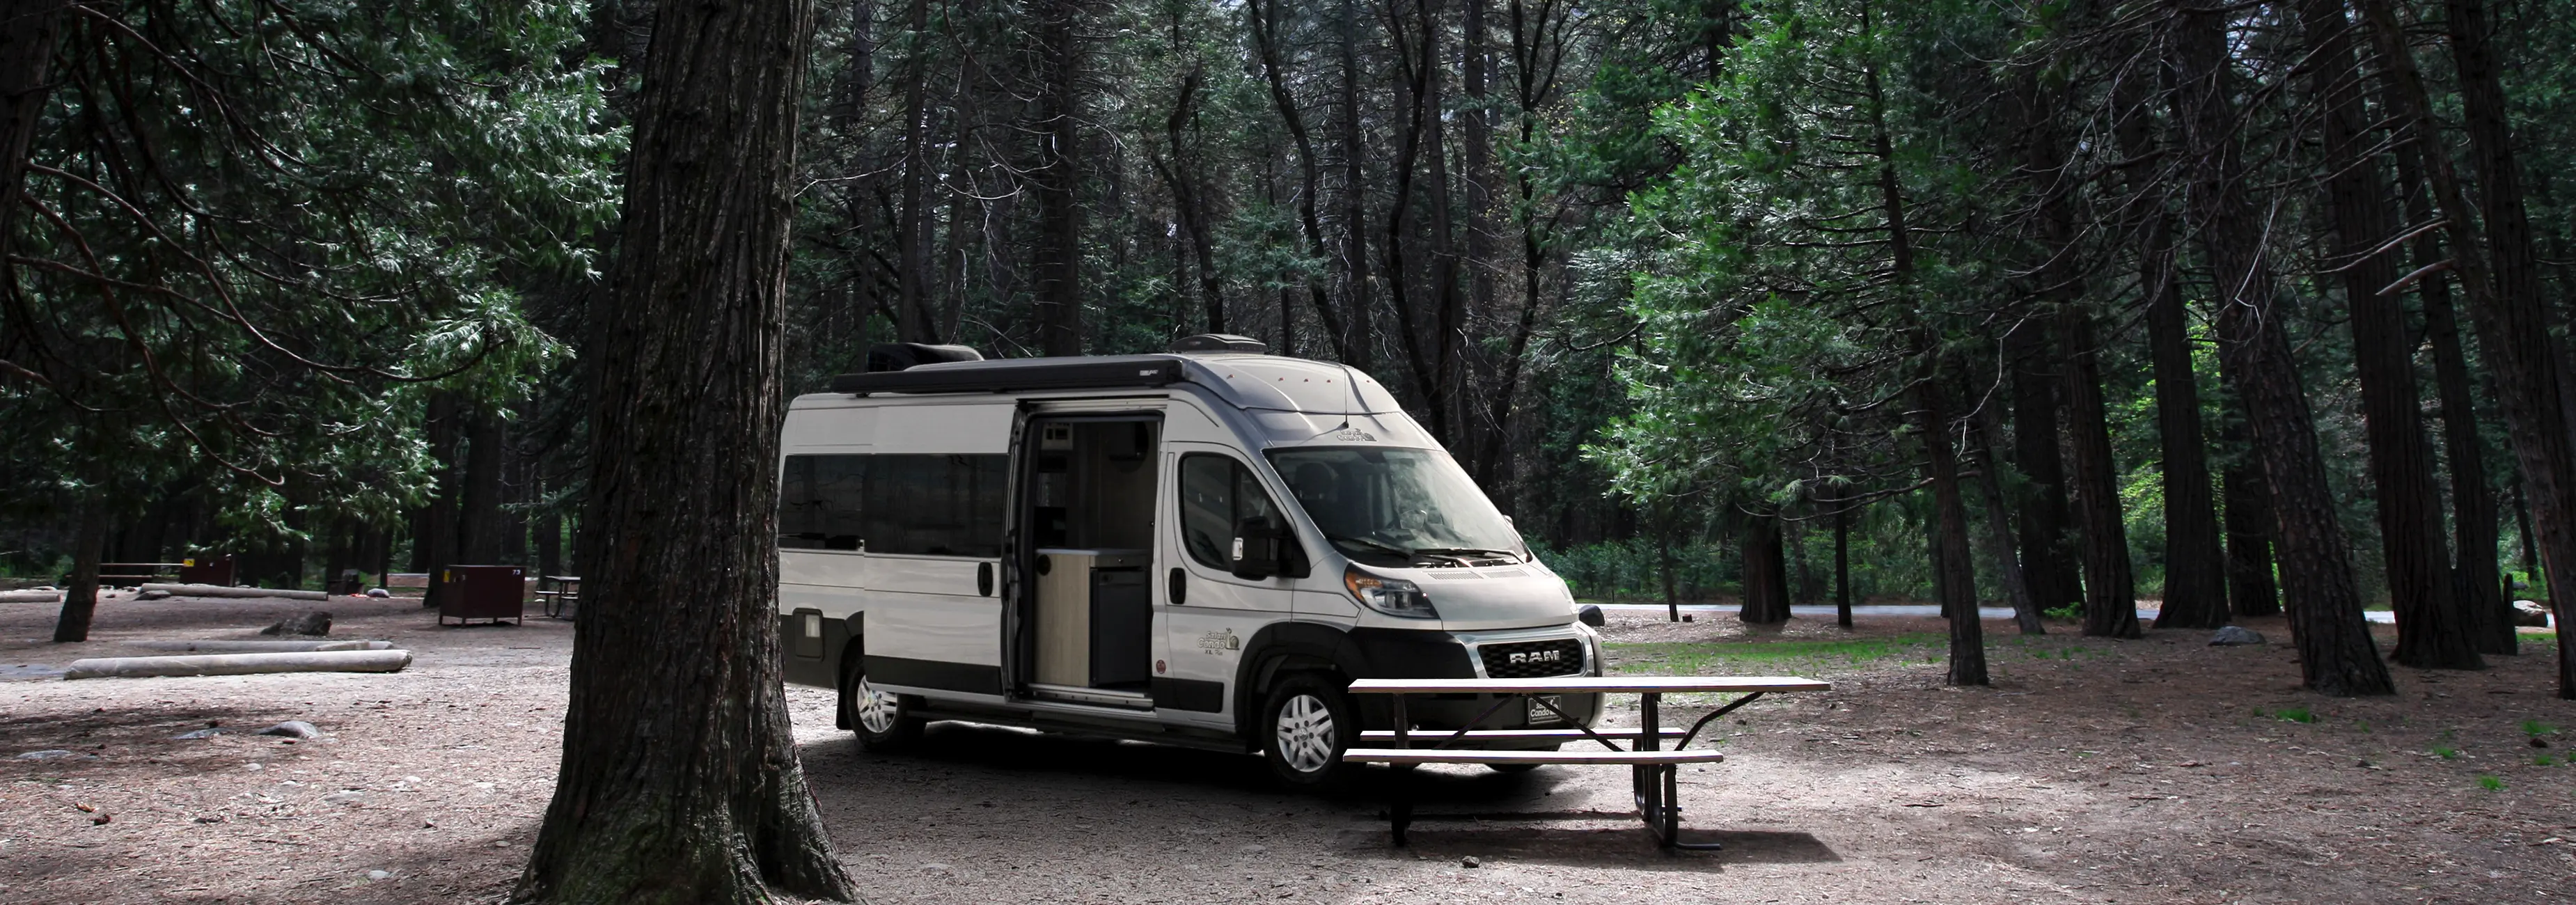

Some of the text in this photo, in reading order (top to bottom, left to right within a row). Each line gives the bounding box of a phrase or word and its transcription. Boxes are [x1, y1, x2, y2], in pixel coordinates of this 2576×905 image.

[1206, 630, 1226, 640] Safari
[1197, 637, 1226, 649] Condo
[1509, 650, 1560, 663] RAM
[1530, 708, 1550, 717] Condo
